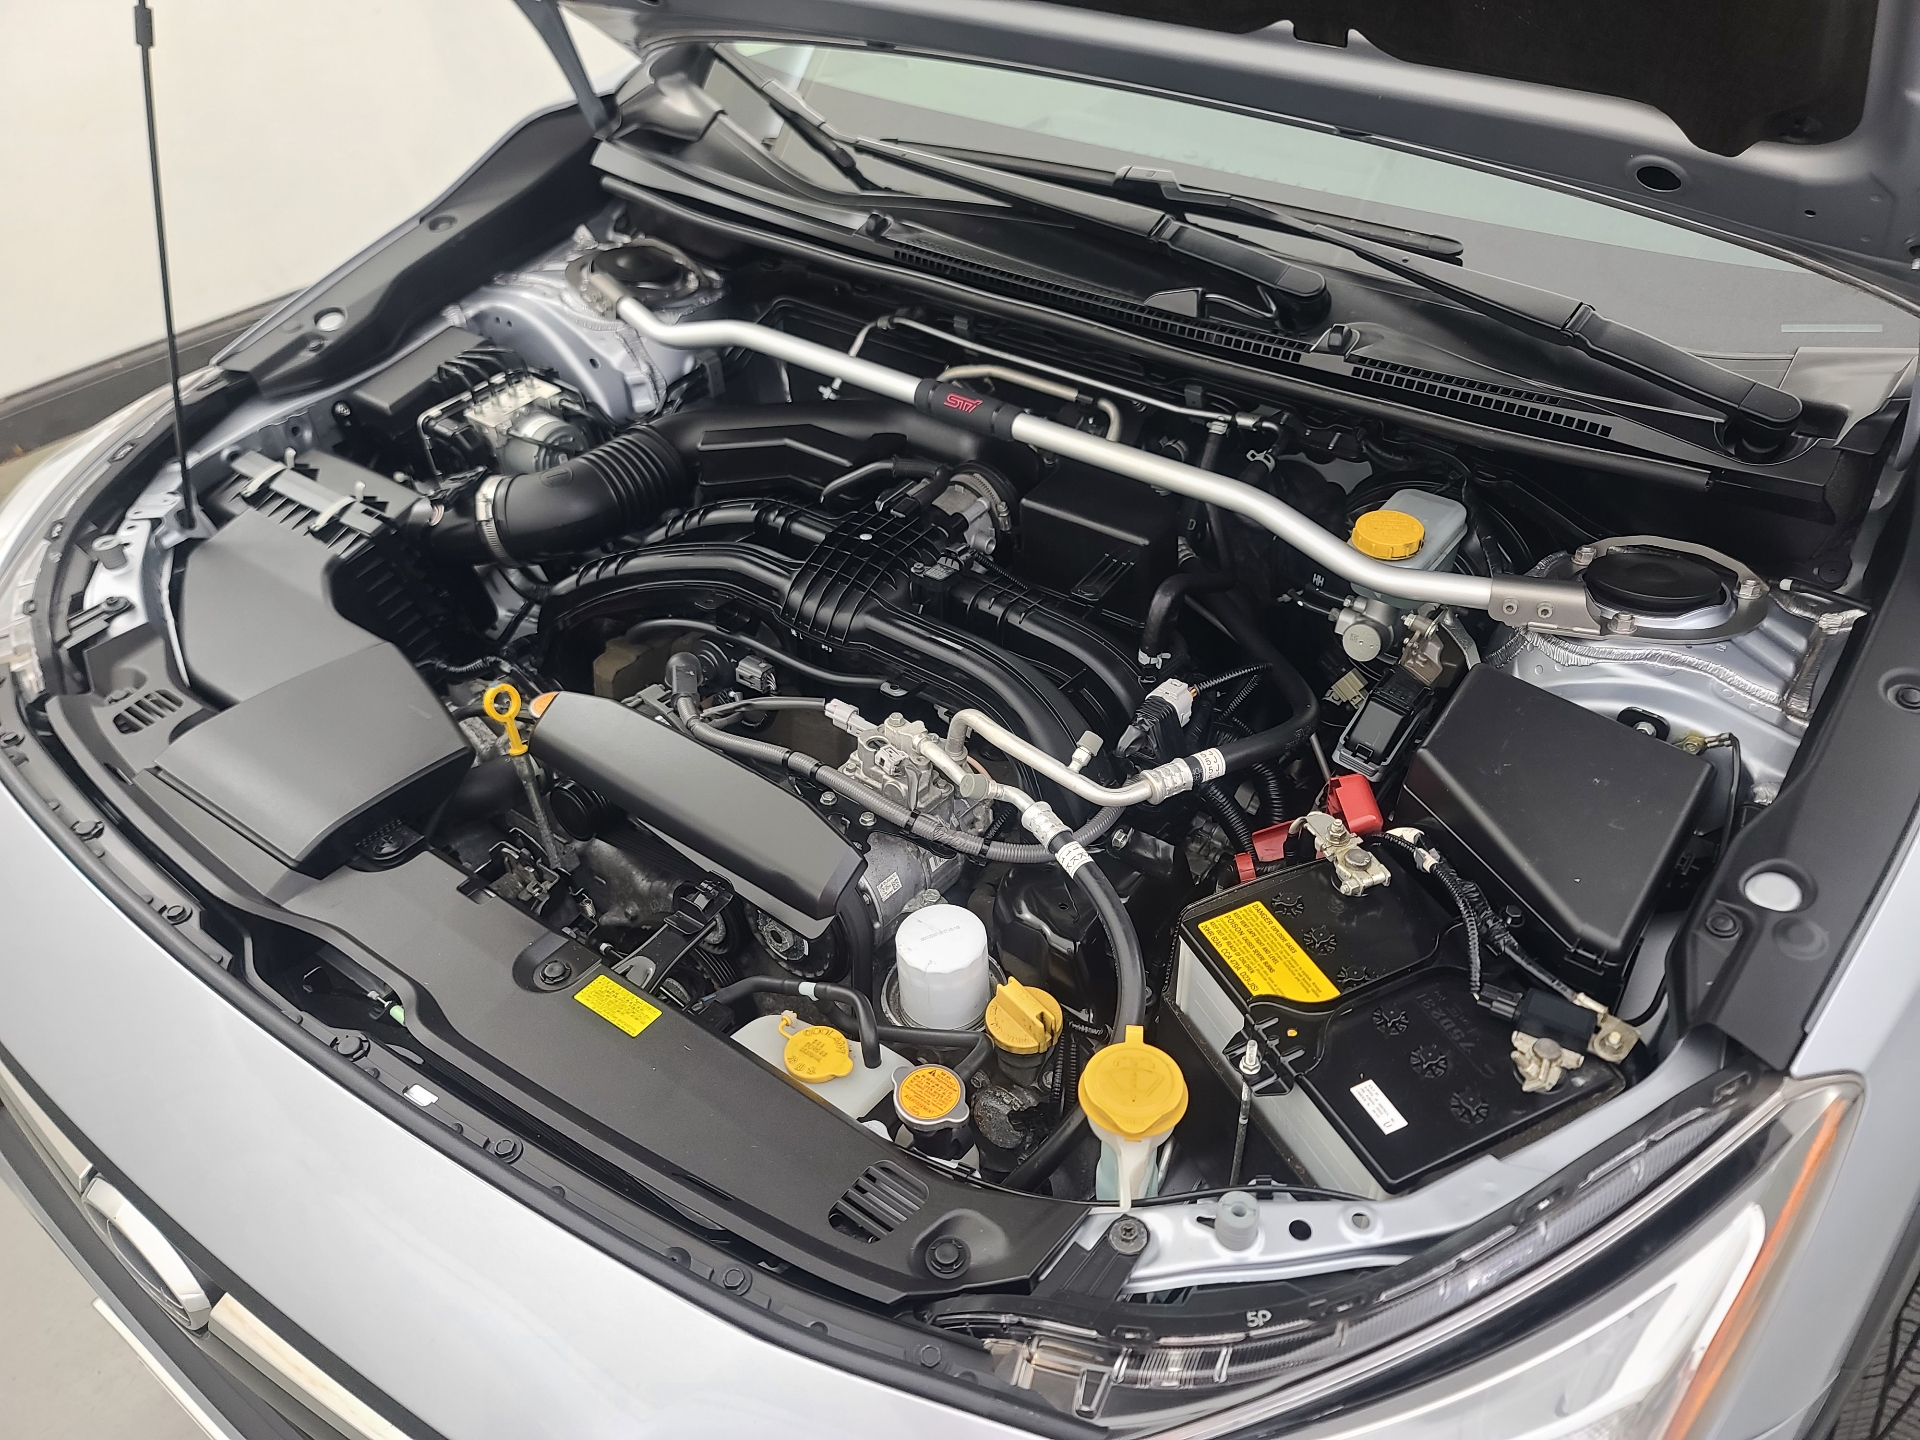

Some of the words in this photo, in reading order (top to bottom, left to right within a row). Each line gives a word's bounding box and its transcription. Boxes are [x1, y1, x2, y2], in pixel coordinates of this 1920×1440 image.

[1252, 904, 1273, 925] DANGER
[1224, 914, 1245, 936] POISON
[1242, 936, 1255, 950] CAUSES
[1247, 928, 1256, 937] CAPS
[1268, 953, 1279, 964] LEVEL
[1221, 948, 1232, 960] CCA
